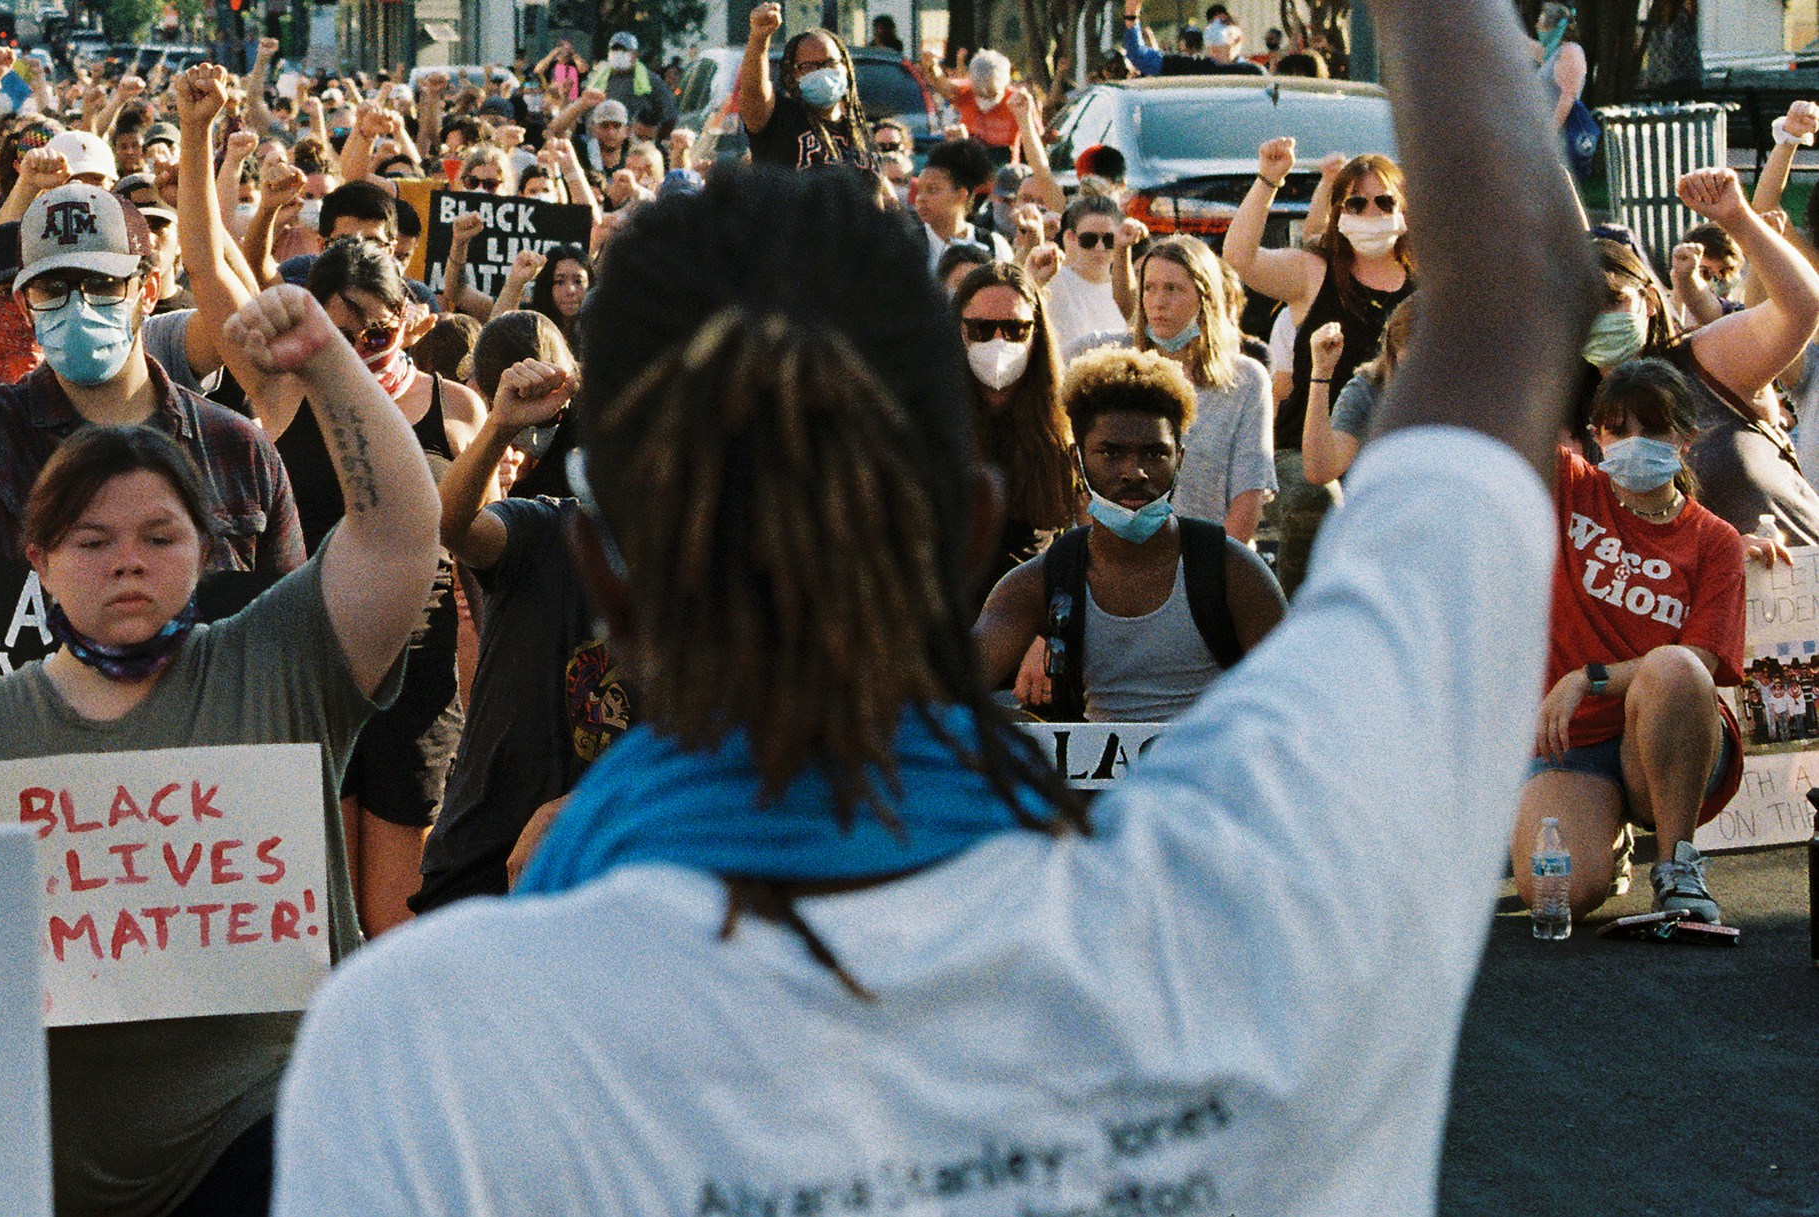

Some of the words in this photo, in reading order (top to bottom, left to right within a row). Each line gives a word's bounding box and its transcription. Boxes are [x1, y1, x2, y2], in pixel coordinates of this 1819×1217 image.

[1567, 511, 1672, 580] Waco
[1582, 559, 1690, 630] Lion
[18, 779, 225, 840] BLACK
[65, 836, 287, 894] LIVES
[48, 888, 319, 963] MATTER!
